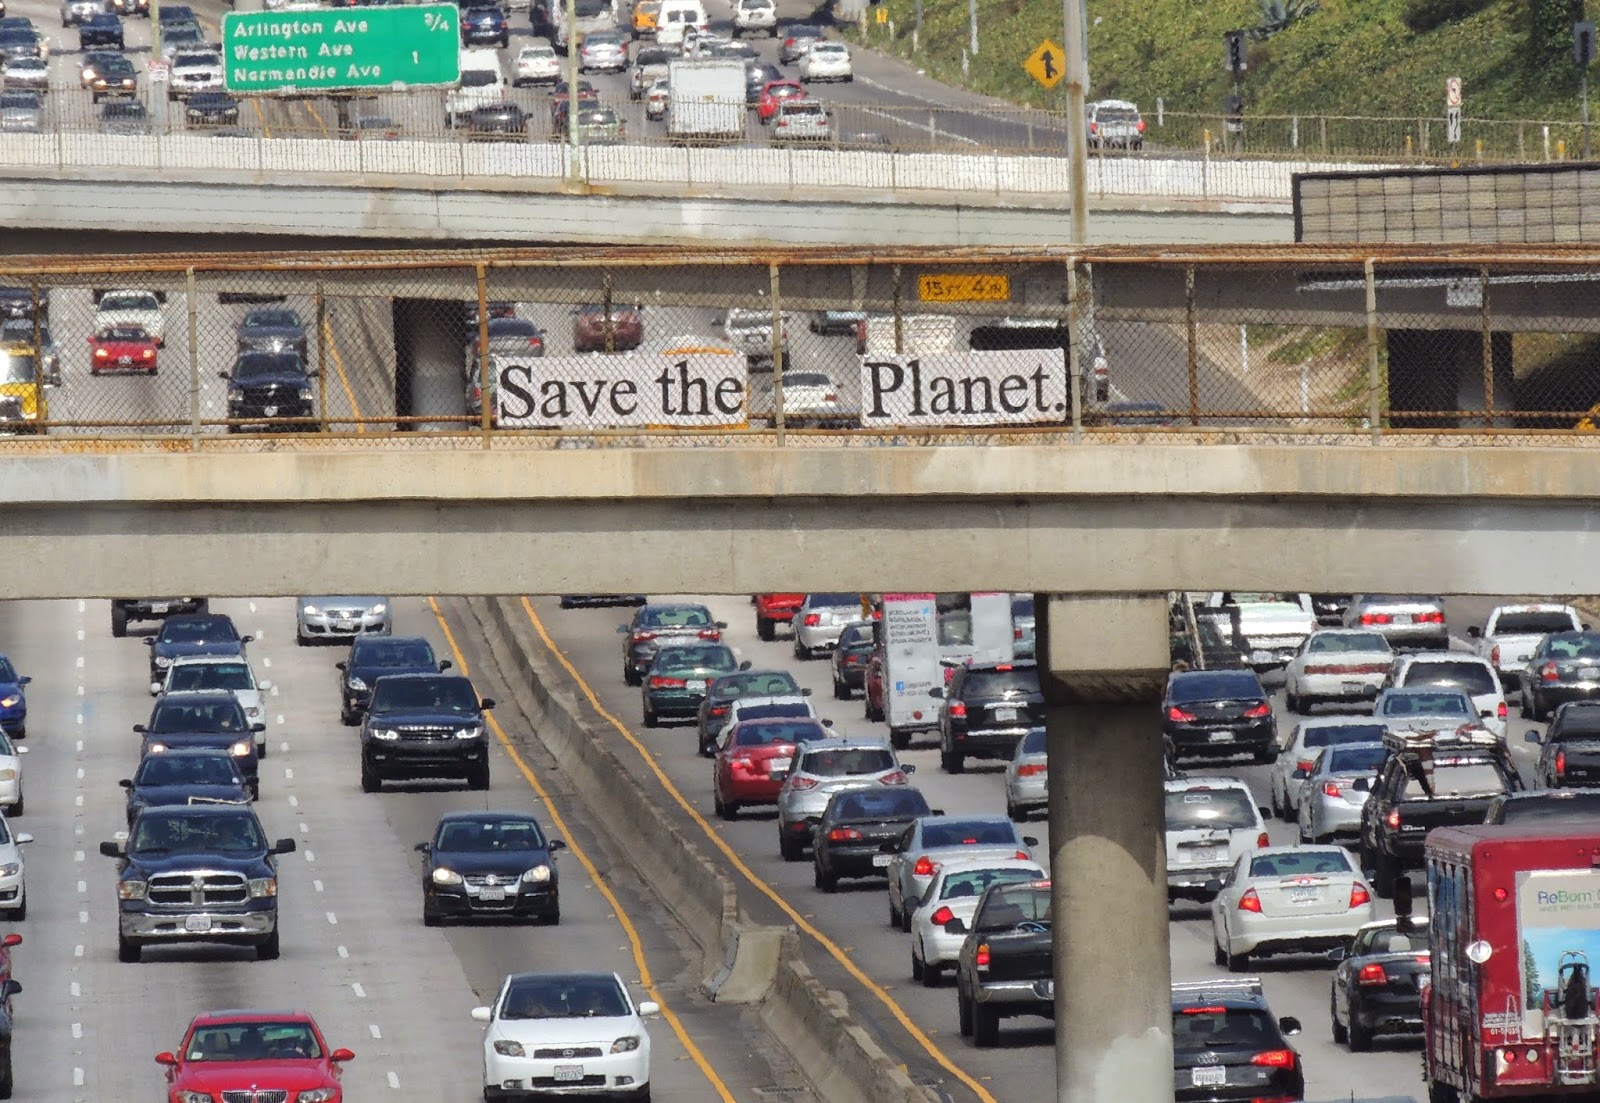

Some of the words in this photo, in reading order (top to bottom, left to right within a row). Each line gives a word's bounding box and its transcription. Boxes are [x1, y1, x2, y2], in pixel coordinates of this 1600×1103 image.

[234, 22, 322, 39] Arlington
[334, 19, 368, 33] Ave
[233, 44, 308, 60] Western
[318, 42, 353, 57] Ave
[234, 65, 337, 82] Normandie
[346, 63, 381, 79] Ave
[499, 364, 637, 420] Save
[655, 360, 744, 416] the
[863, 359, 1066, 418] Planet.
